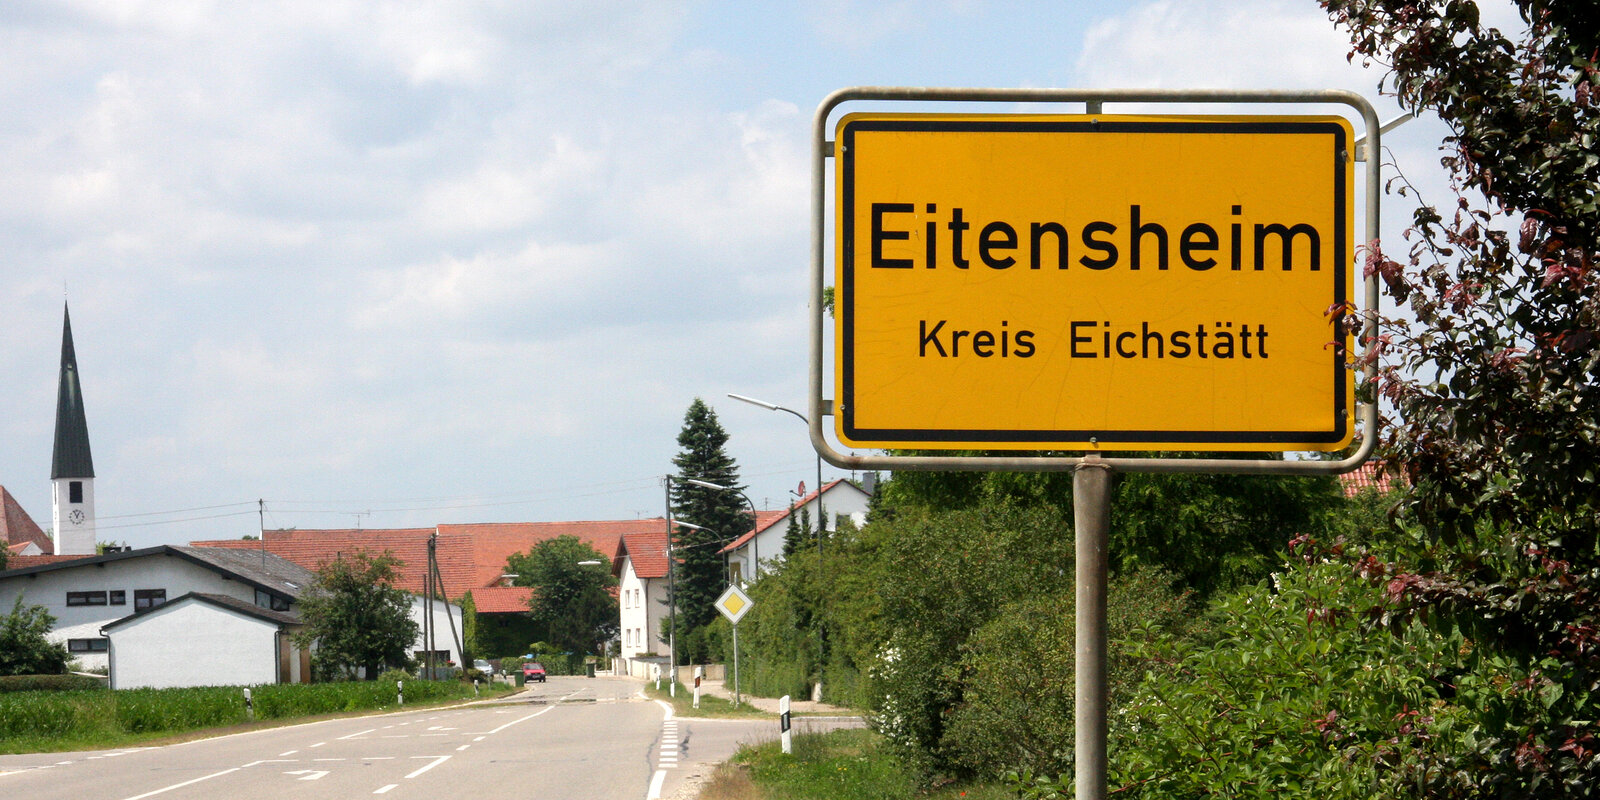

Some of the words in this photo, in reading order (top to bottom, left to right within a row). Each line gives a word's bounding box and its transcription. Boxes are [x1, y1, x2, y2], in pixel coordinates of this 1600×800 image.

[870, 202, 1321, 272] Eitensheim
[919, 319, 1036, 359] Kreis
[1069, 320, 1269, 359] Eichstätt
